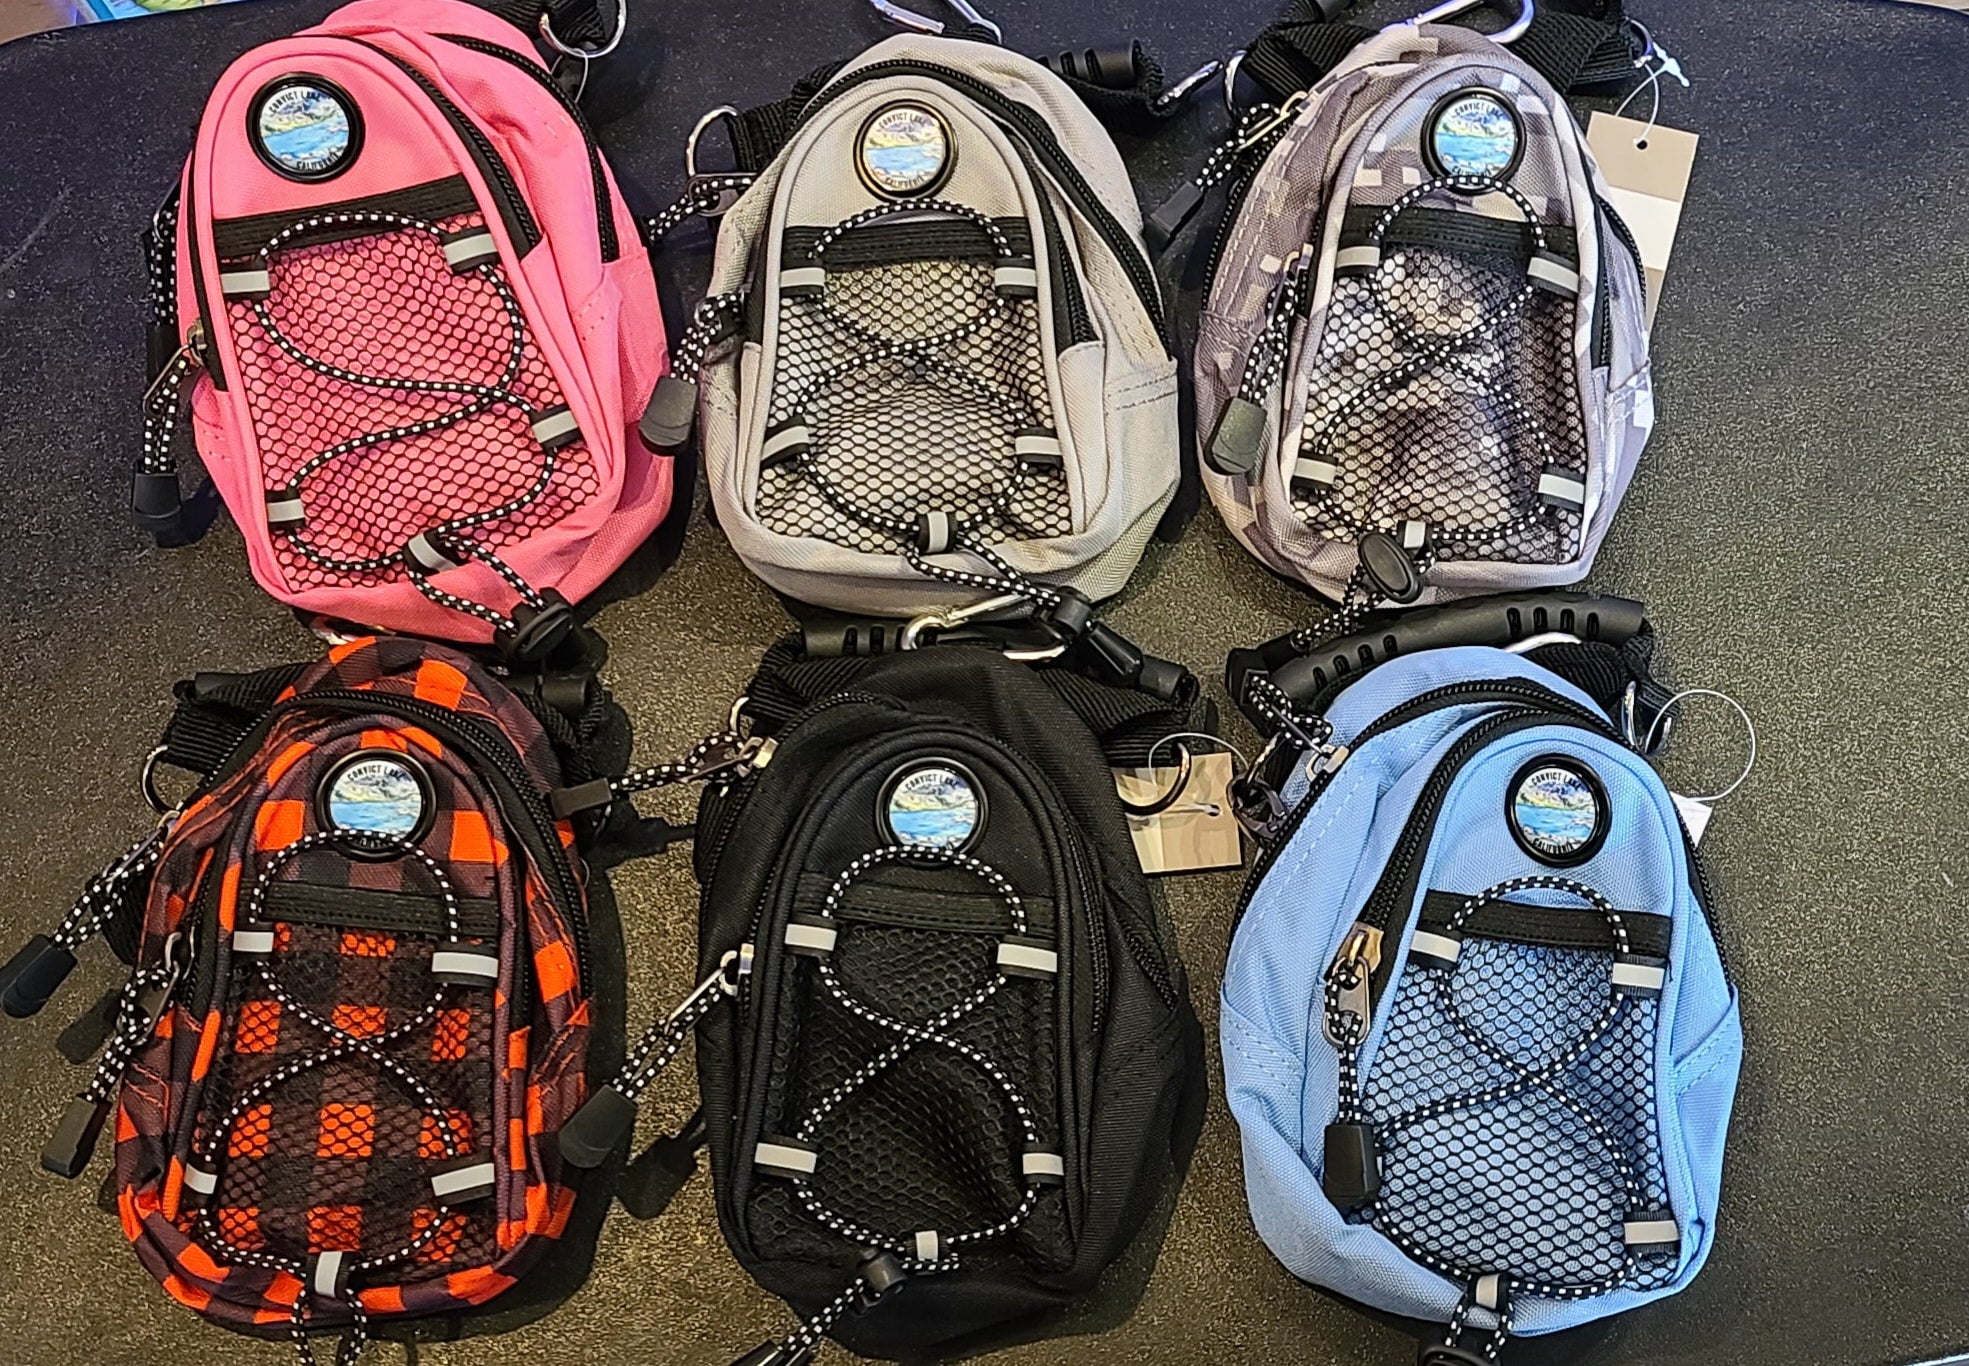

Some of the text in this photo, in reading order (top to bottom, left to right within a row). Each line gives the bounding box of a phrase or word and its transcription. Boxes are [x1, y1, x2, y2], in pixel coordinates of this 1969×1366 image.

[347, 765, 381, 781] CONVICT
[1531, 772, 1562, 786] CONVICT
[905, 774, 938, 790] CONVICT
